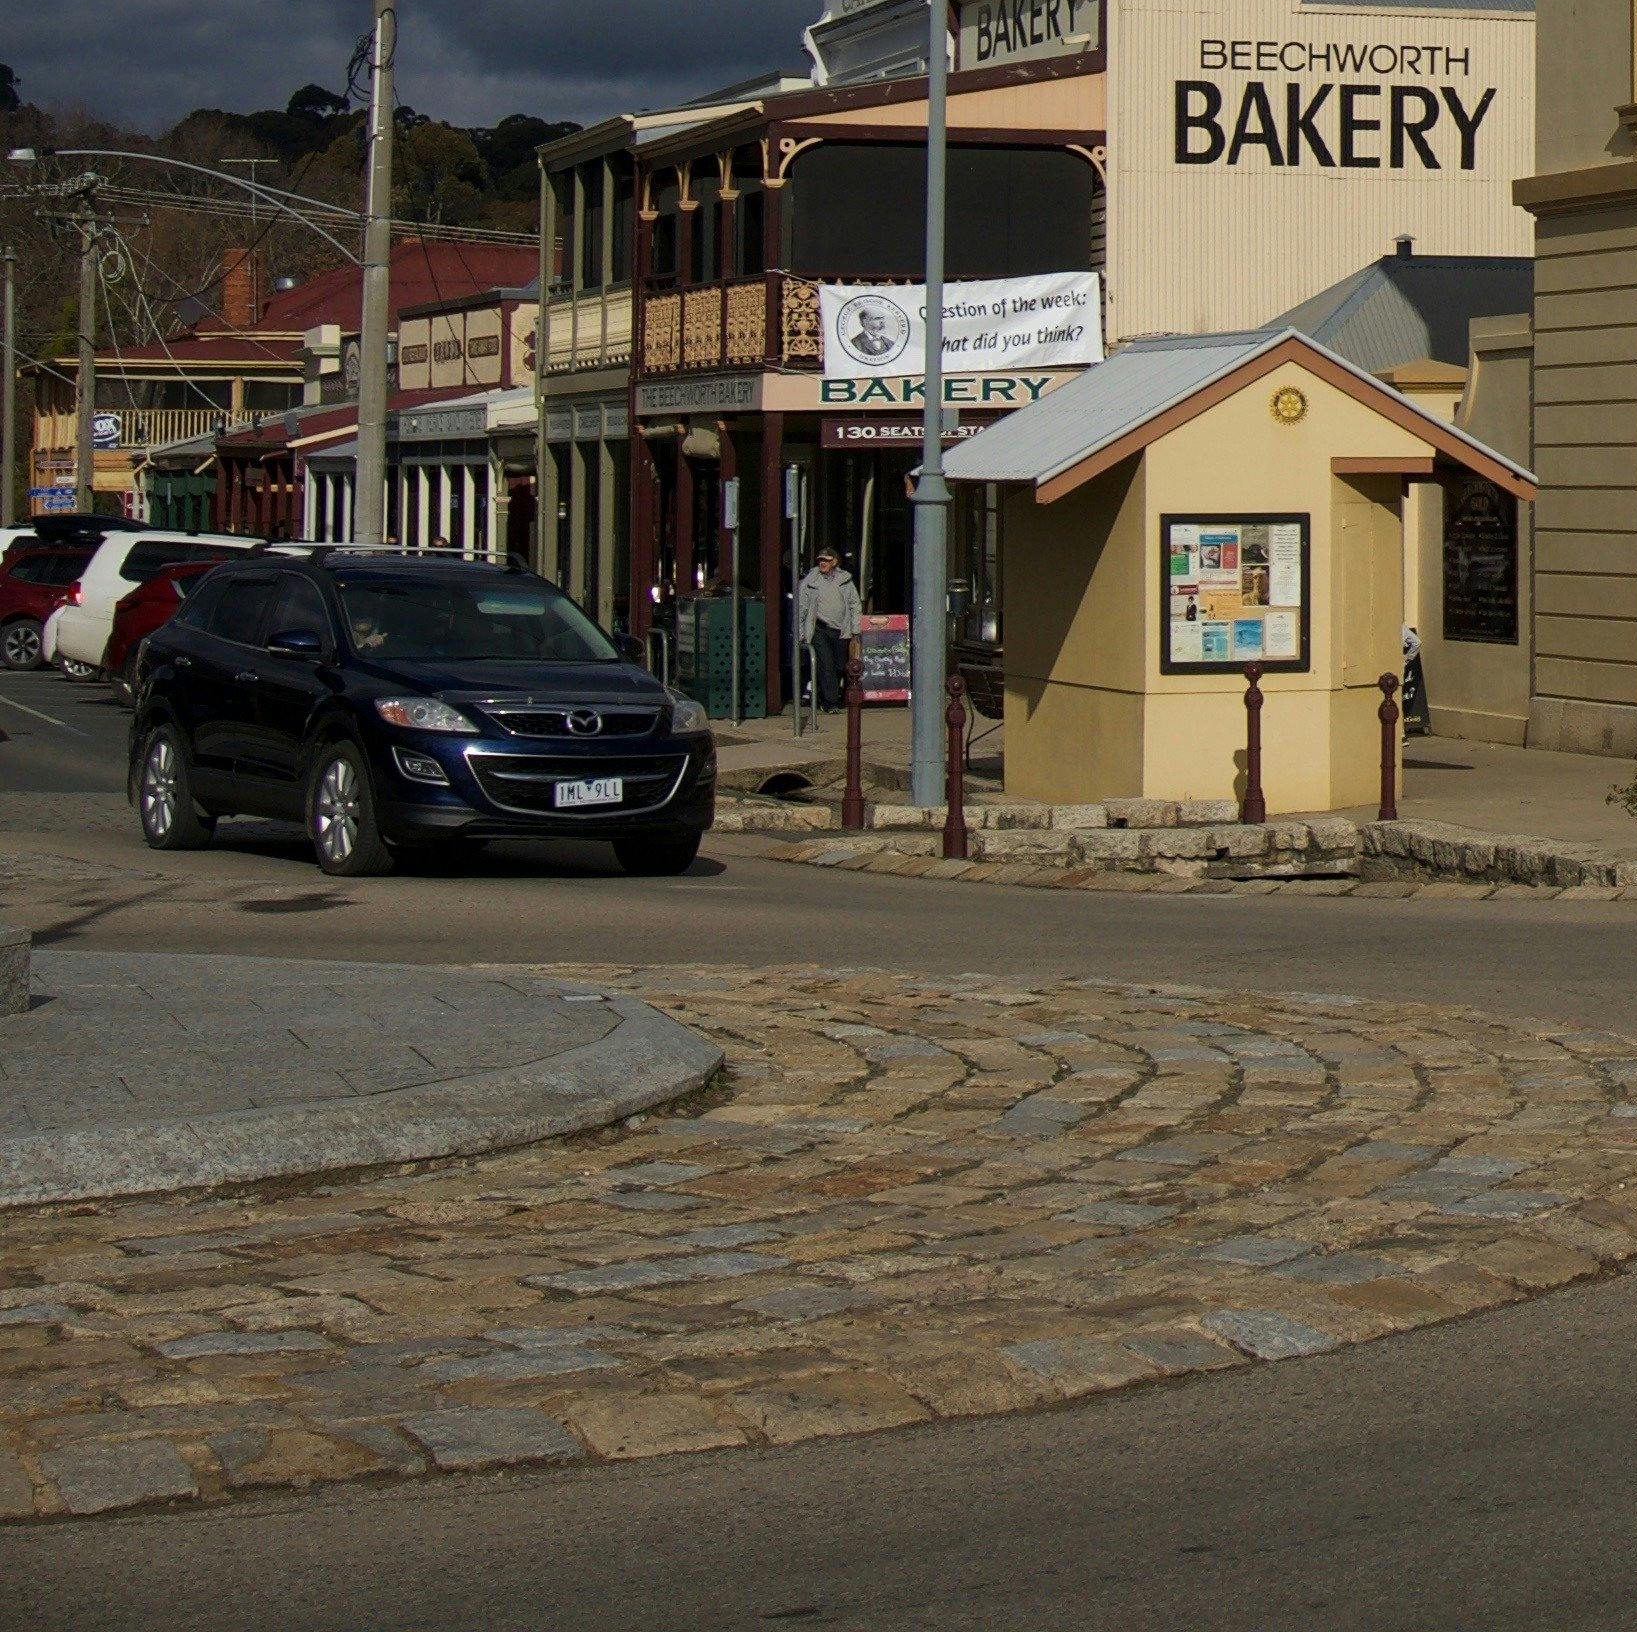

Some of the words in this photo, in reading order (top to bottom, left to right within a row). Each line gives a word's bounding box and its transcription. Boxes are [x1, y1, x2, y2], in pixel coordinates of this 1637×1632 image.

[1200, 39, 1470, 76] BEECHWORTH
[1174, 79, 1498, 171] BAKERY
[919, 301, 987, 320] Qestion
[992, 298, 1008, 314] of
[1012, 295, 1036, 312] the
[1040, 290, 1087, 309] week:
[973, 330, 997, 350] did
[1002, 333, 1031, 355] you
[1037, 325, 1084, 344] think?
[820, 376, 1052, 404] BAKERY
[836, 426, 877, 439] 130
[560, 784, 583, 801] 1ML
[595, 781, 621, 798] 9LL
